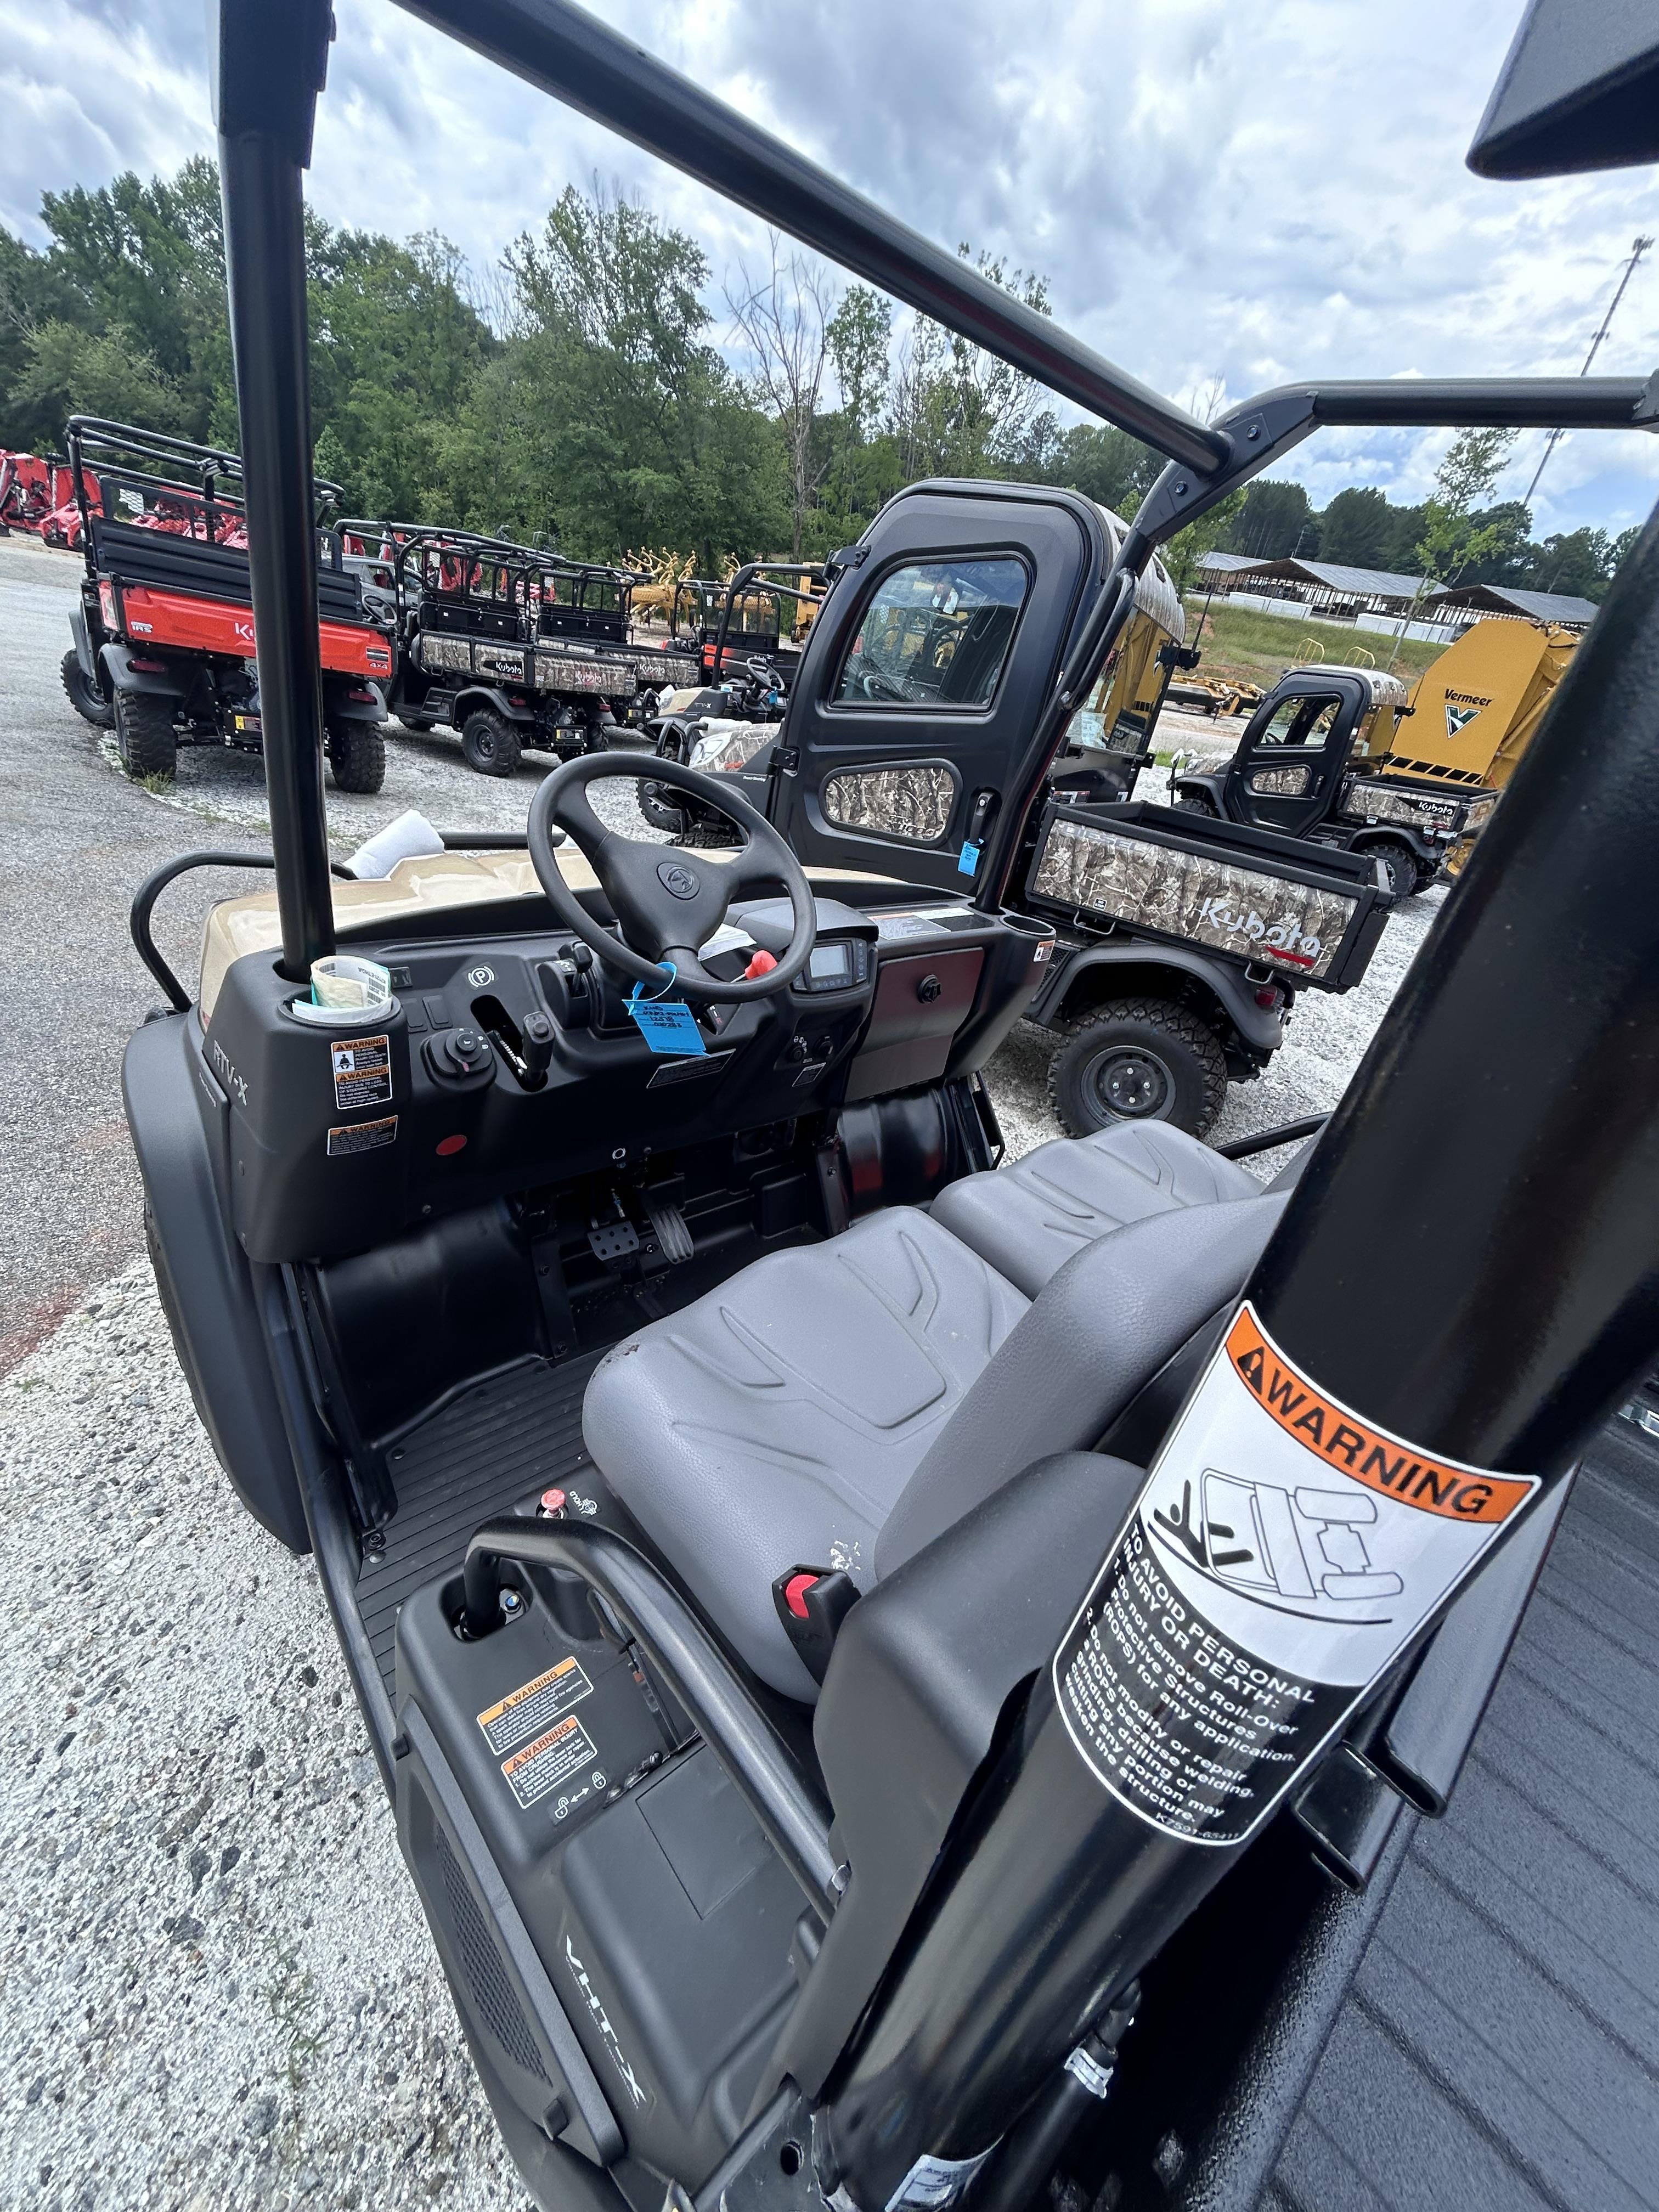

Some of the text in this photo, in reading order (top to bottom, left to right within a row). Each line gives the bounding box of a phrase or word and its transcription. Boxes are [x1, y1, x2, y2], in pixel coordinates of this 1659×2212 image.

[496, 661, 522, 675] Kubota
[575, 670, 602, 684] Kubota
[639, 663, 665, 676] Kubota
[1444, 688, 1493, 707] Vermeer
[1418, 801, 1453, 815] Kubota
[1063, 825, 1143, 853] DIESEL
[1200, 897, 1321, 957] Kubota
[345, 1038, 385, 1049] WARNING
[213, 1040, 249, 1107] RTV-X
[347, 1067, 387, 1079] WARNING
[351, 1119, 391, 1132] WARNING
[1267, 1368, 1493, 1515] WARNING
[569, 1491, 583, 1508] HOLD
[1123, 1538, 1279, 1708] INJURY OR DEATH:
[1131, 1522, 1314, 1703] TO AVOID PERSONAL
[1111, 1588, 1257, 1740] Protective Structures
[1118, 1574, 1130, 1600] Do
[1129, 1602, 1148, 1633] not
[1148, 1633, 1206, 1693] remove
[1209, 1690, 1299, 1735] Roll-Over
[512, 1671, 557, 1703] WARNING
[1103, 1601, 1296, 1762] (ROPS) for any application.
[523, 1706, 533, 1714] may
[1084, 1639, 1090, 1651] a
[1088, 1651, 1116, 1703] ROPS
[1116, 1702, 1181, 1767] because
[1090, 1624, 1101, 1651] Do
[1100, 1652, 1118, 1683] not
[1118, 1684, 1168, 1739] modify
[1170, 1739, 1191, 1756] or
[1193, 1754, 1247, 1781] repair
[498, 1718, 507, 1726] can
[509, 1770, 518, 1779] TO
[518, 1758, 535, 1773] AVOID
[534, 1740, 561, 1762] PERSONAL
[560, 1728, 578, 1743] INJURY
[522, 1723, 570, 1760] WARNING
[565, 1741, 575, 1751] lock
[1065, 1672, 1196, 1822] weaken the structure.
[1071, 1662, 1225, 1818] cutting any portion may
[1118, 1728, 1173, 1780] drilling
[1176, 1778, 1197, 1791] or
[512, 1769, 528, 1783] FROM
[524, 1784, 534, 1792] The
[544, 1769, 555, 1778] lock
